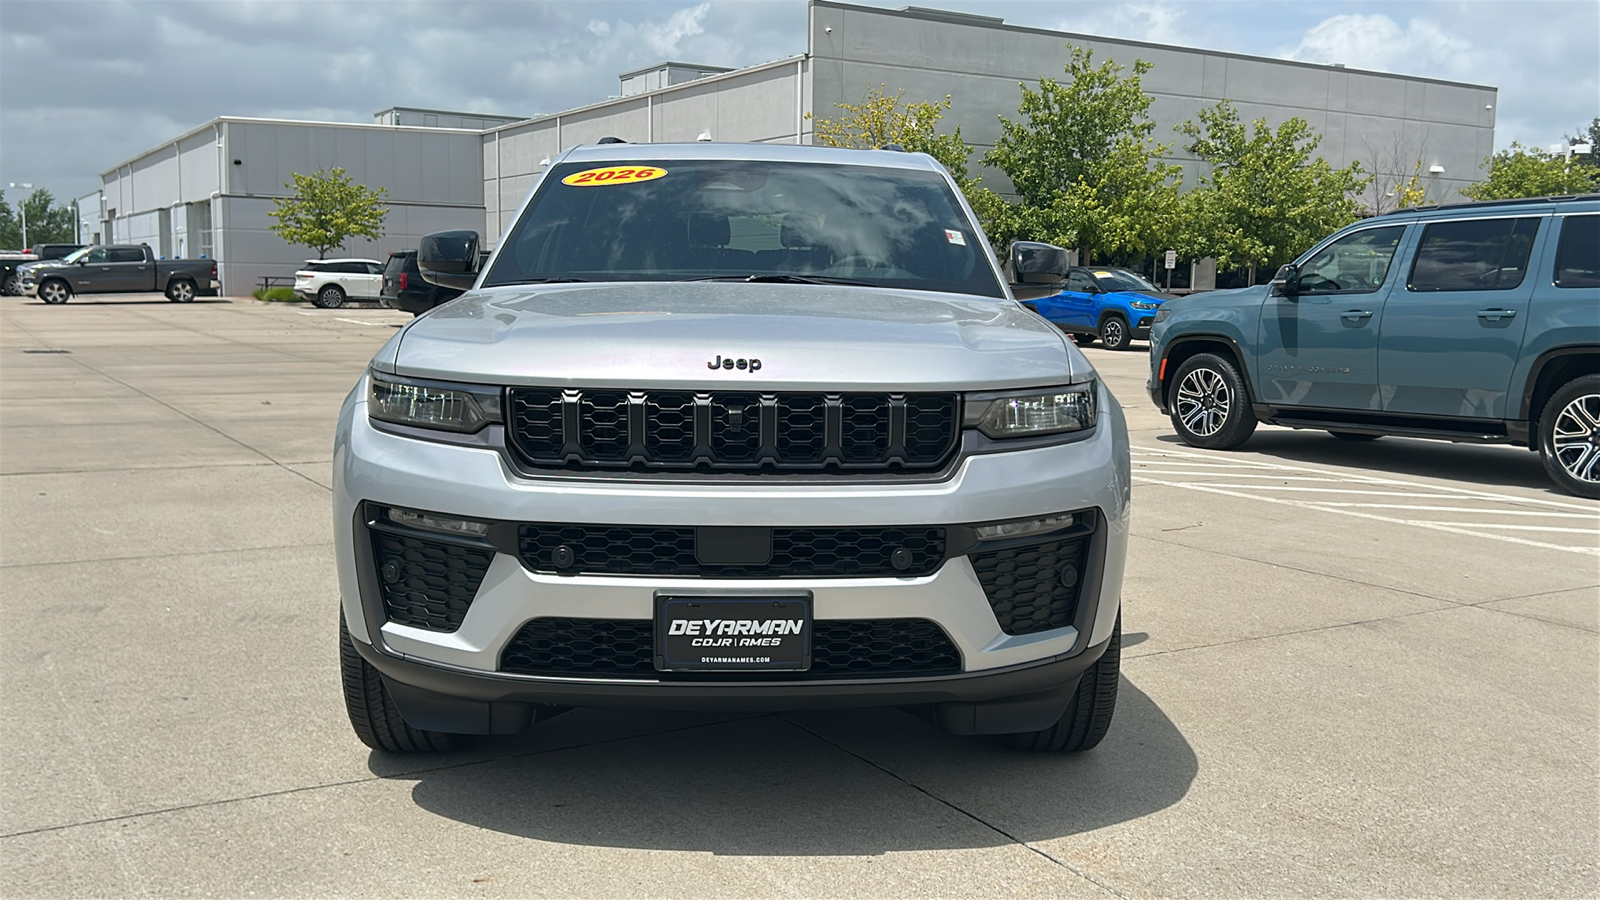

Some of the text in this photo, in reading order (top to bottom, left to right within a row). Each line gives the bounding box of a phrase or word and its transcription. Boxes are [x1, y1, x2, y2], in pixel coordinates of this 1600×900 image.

[572, 168, 656, 184] 2026
[707, 354, 762, 373] Jeep
[668, 619, 804, 636] DEYARMAN
[691, 637, 782, 647] CDJR AMES
